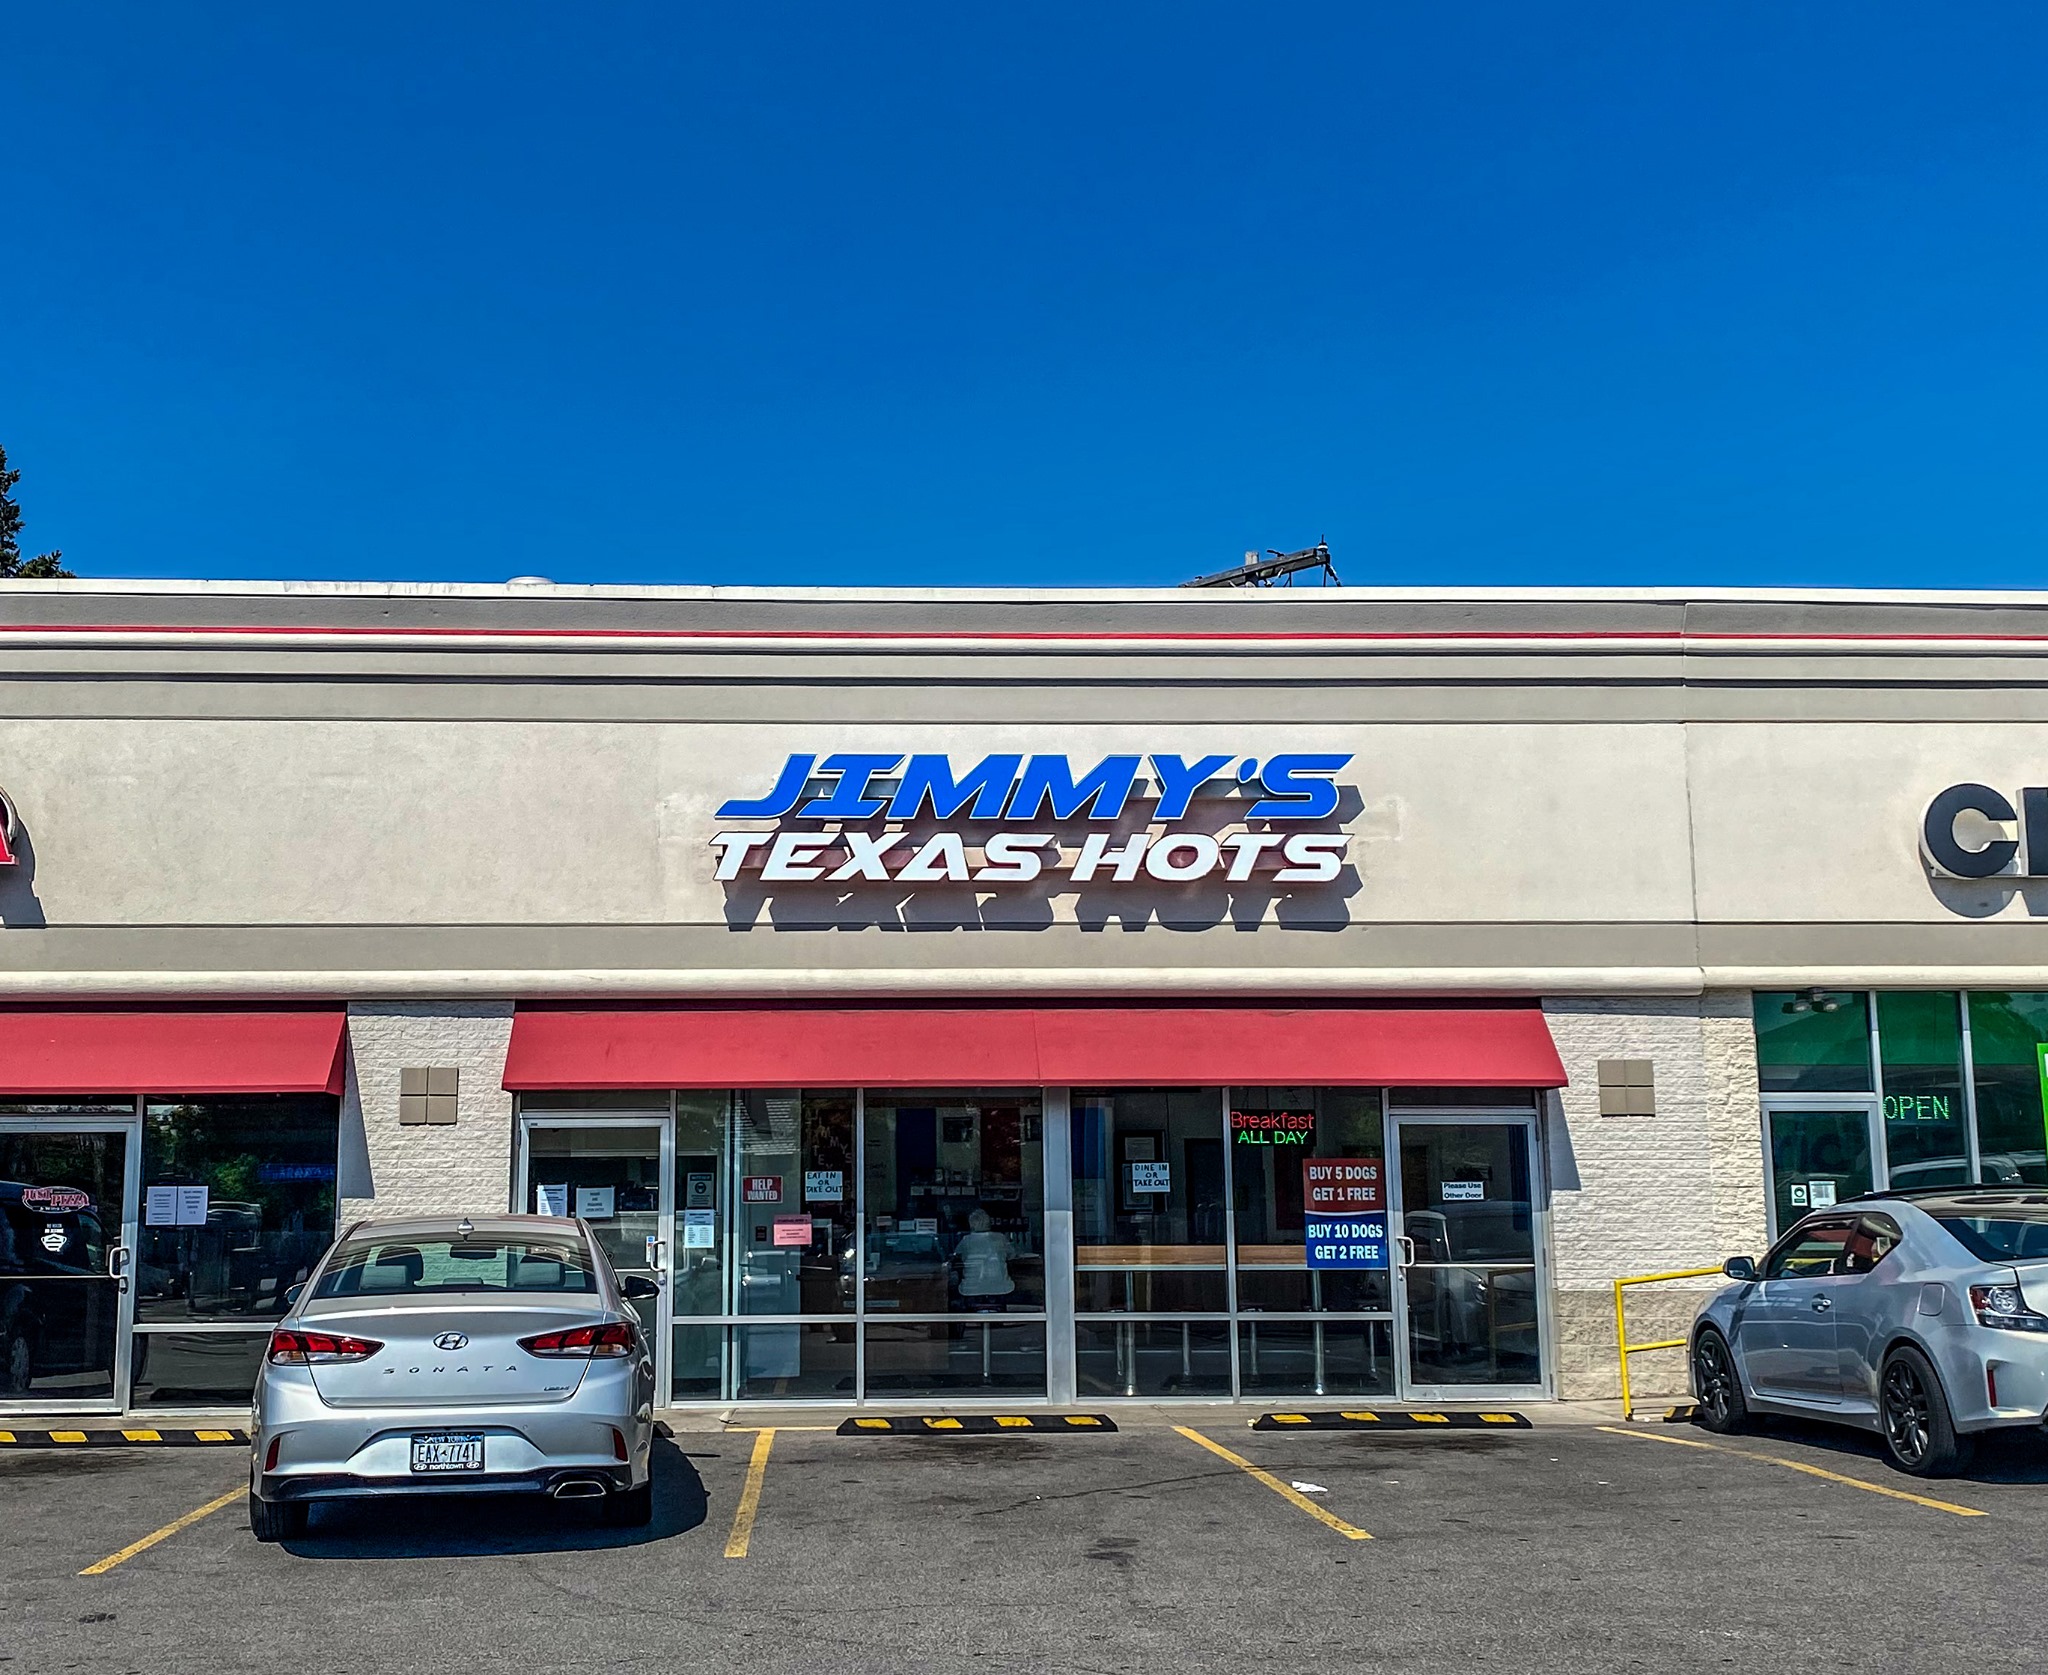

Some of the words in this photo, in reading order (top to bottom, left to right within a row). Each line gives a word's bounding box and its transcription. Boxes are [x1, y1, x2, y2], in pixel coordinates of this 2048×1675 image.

[714, 753, 1357, 820] JIMMY'S
[709, 831, 1056, 882] TEXAS
[1069, 831, 1355, 882] HOTS
[1883, 1095, 1950, 1120] OPEN
[1231, 1111, 1314, 1130] Breakfast
[1238, 1130, 1270, 1144] ALL
[1274, 1131, 1308, 1145] DAY
[1309, 1166, 1333, 1180] BUY
[1335, 1167, 1343, 1180] 5
[1345, 1166, 1378, 1180] DOGS
[751, 1178, 774, 1191] HELP
[1134, 1179, 1153, 1187] TAKE
[1153, 1179, 1170, 1187] OUT
[23, 1188, 53, 1201] JUST
[50, 1194, 90, 1206] PIZZA
[747, 1190, 778, 1201] WANTED
[1312, 1187, 1335, 1201] GET
[1336, 1187, 1345, 1201] 1
[1347, 1187, 1376, 1201] FREE
[1308, 1224, 1333, 1239] BUY
[1334, 1224, 1350, 1239] 10
[1351, 1224, 1384, 1239] DOGS
[1314, 1245, 1337, 1260] GET
[1339, 1245, 1348, 1260] 2
[1350, 1245, 1379, 1260] FREE
[383, 1365, 518, 1375] SONATA
